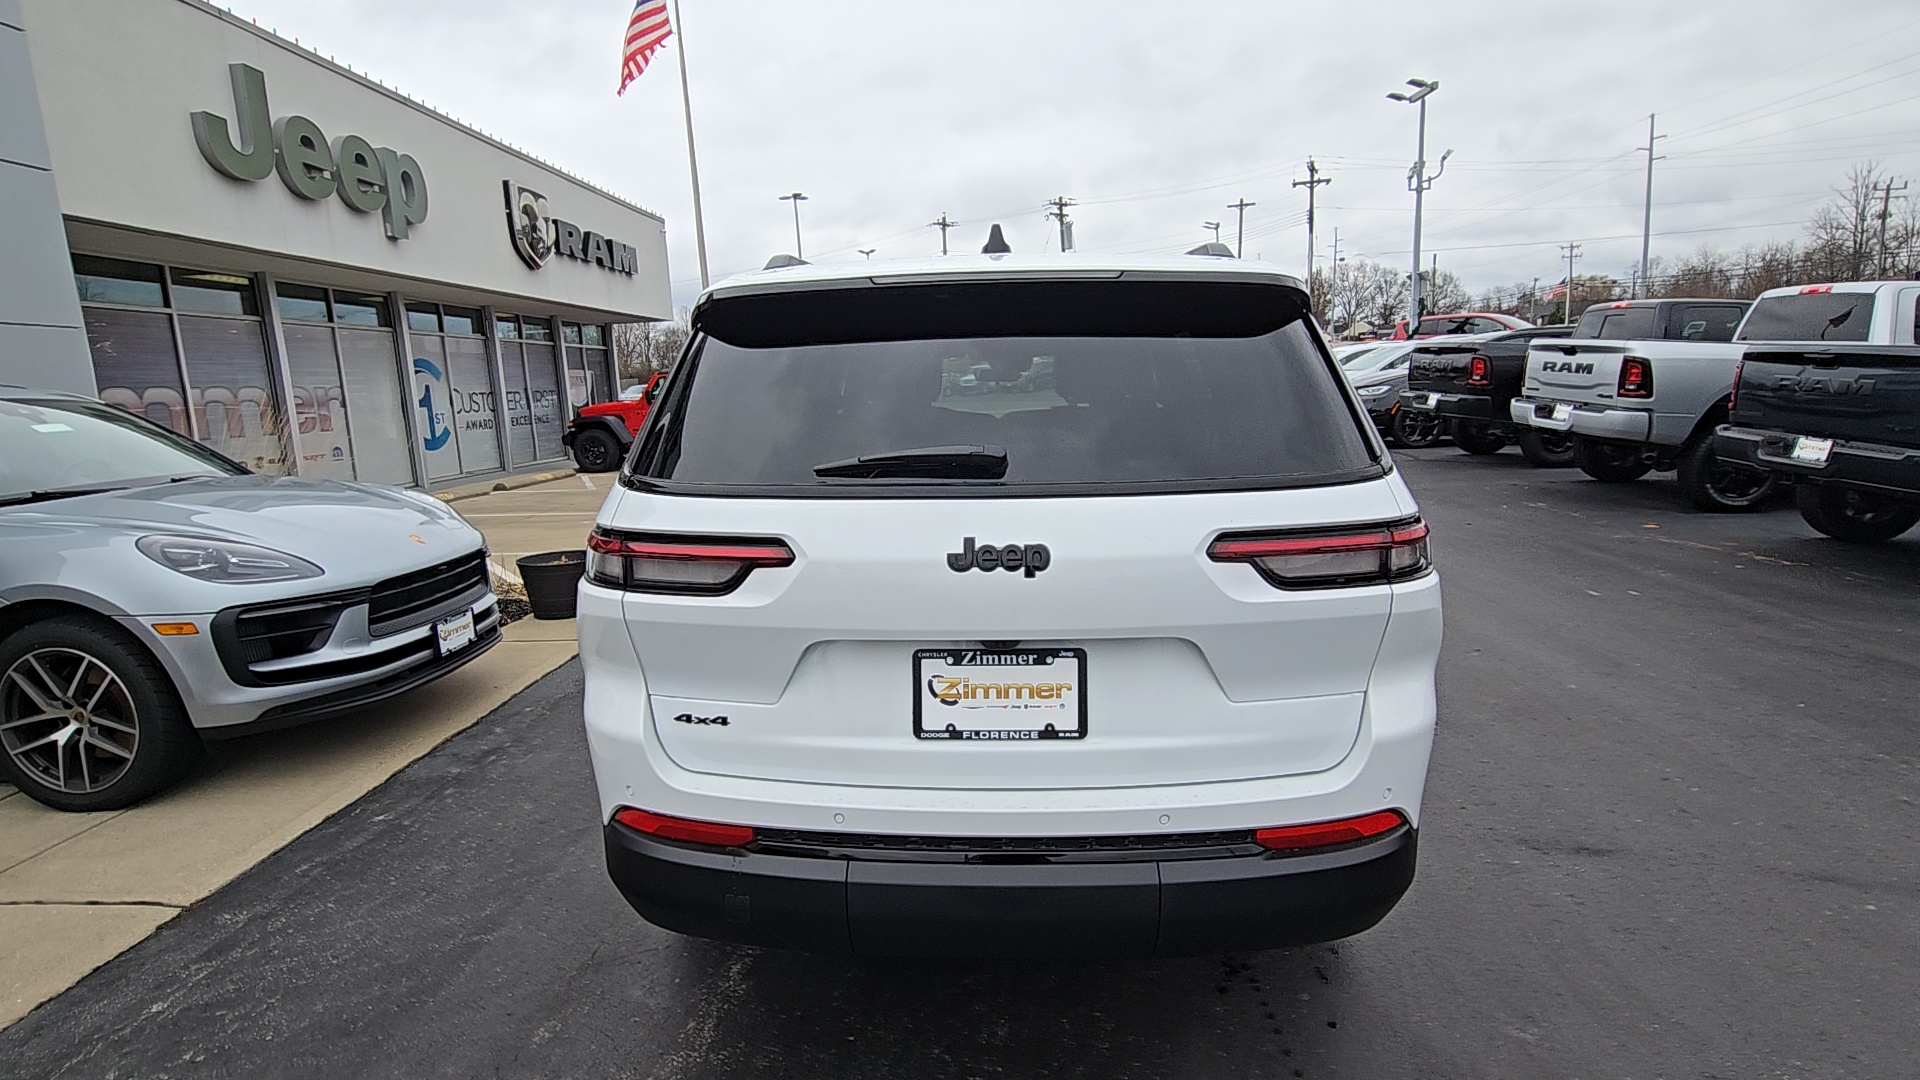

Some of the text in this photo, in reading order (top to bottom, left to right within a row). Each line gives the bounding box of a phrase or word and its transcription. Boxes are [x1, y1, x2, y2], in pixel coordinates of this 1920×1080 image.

[191, 62, 429, 241] Jeep
[551, 219, 639, 276] RAM
[1542, 361, 1595, 375] RAM
[1773, 374, 1877, 396] RAM
[465, 418, 494, 432] AWARD
[511, 413, 551, 427] EXCELENCE
[946, 536, 1051, 579] Jeep
[961, 651, 1038, 665] Zimmer
[1058, 650, 1075, 658] Jeep
[936, 676, 1073, 700] Zimmer
[672, 713, 732, 727] 4x4
[962, 731, 1040, 739] FLORENCE
